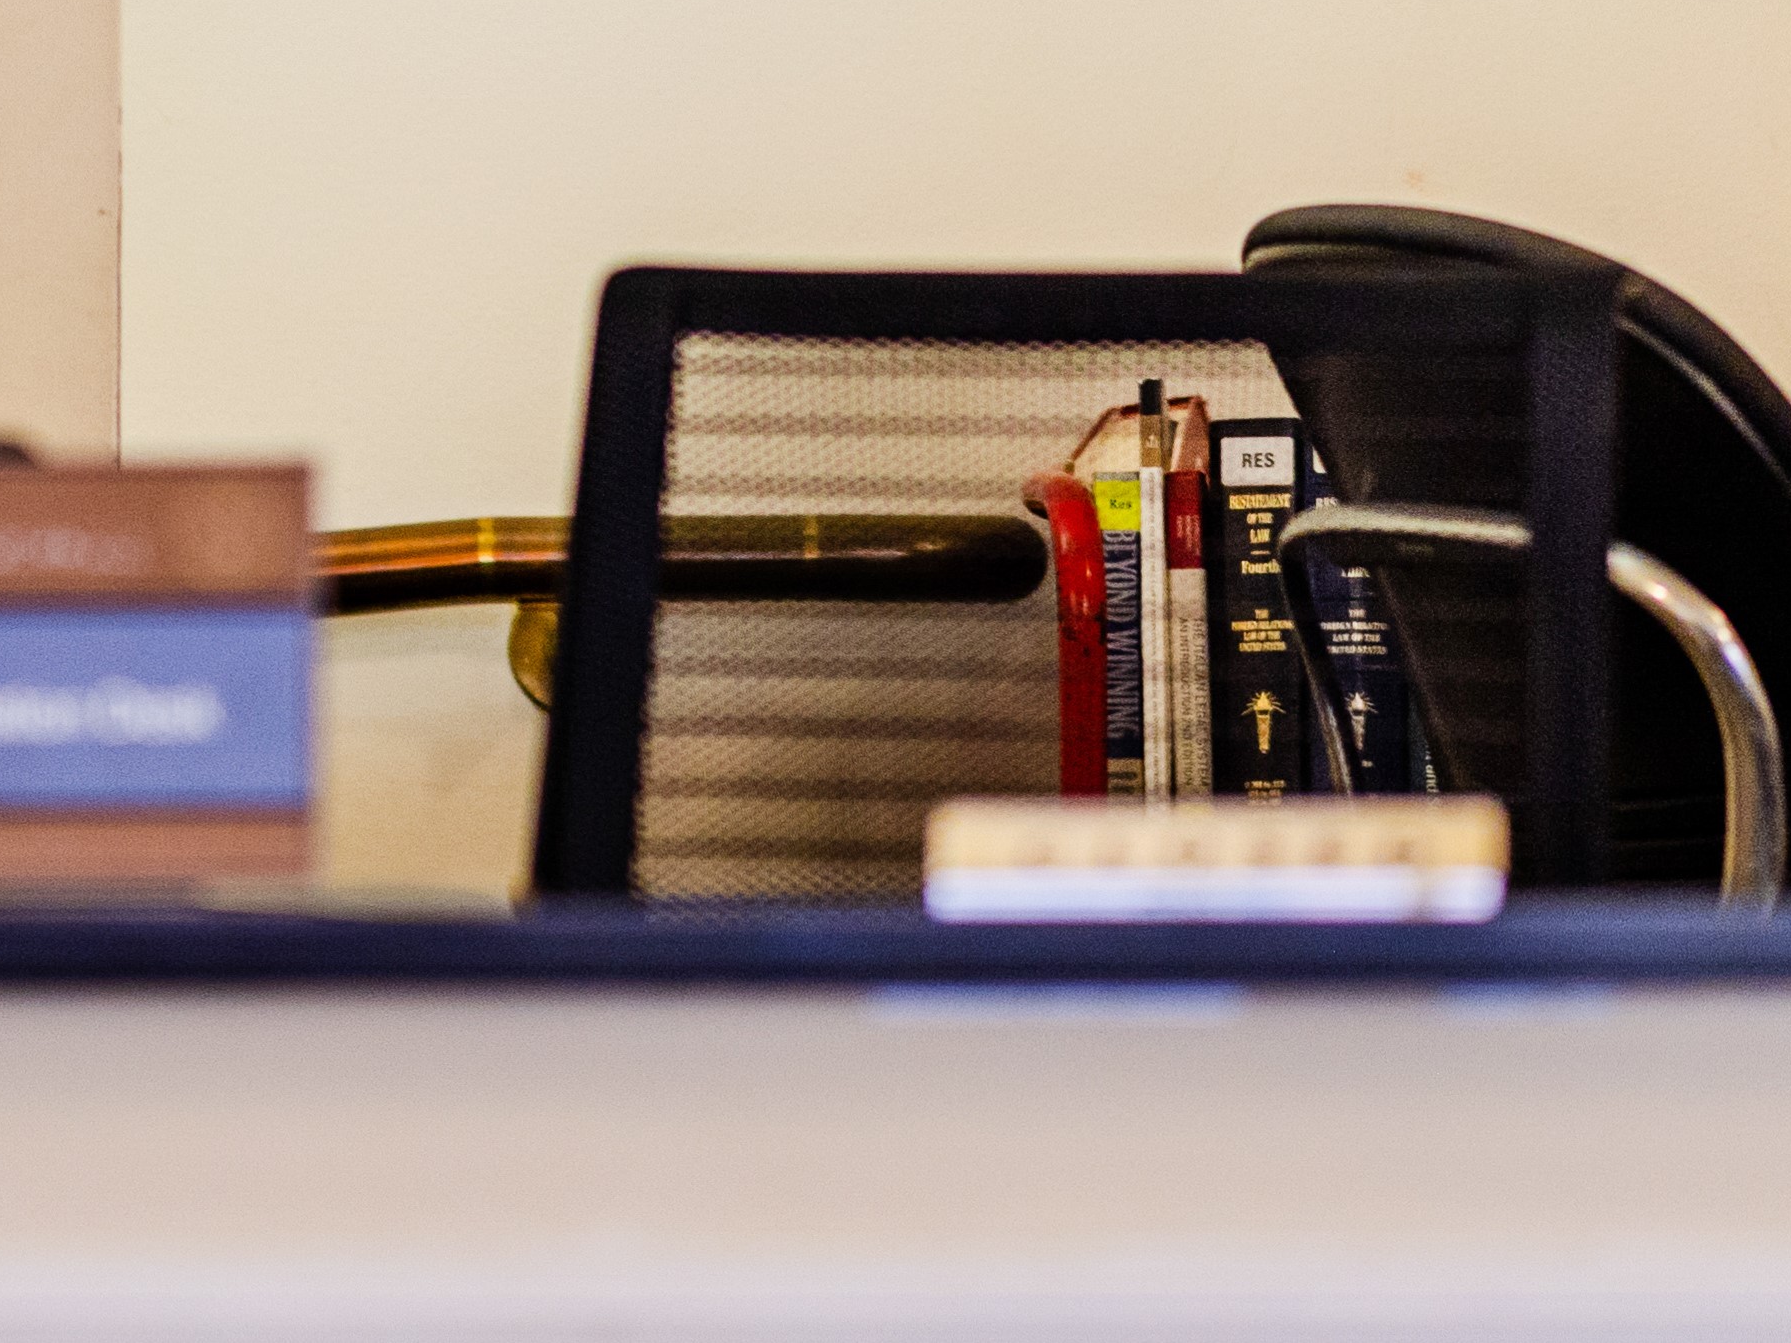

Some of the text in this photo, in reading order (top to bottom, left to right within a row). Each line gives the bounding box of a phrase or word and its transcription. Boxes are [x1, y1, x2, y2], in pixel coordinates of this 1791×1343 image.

[1242, 453, 1275, 468] RES
[1109, 498, 1132, 510] Res
[1250, 528, 1270, 543] LAW
[1241, 560, 1281, 574] Fourth
[1104, 530, 1140, 739] BEYOND WINNING
[1178, 634, 1192, 715] INTRODUCTION
[1193, 644, 1207, 692] ITALIAN
[1194, 696, 1208, 731] LEGAL
[1180, 743, 1194, 786] EDITION
[1196, 736, 1210, 788] SYSTEM
